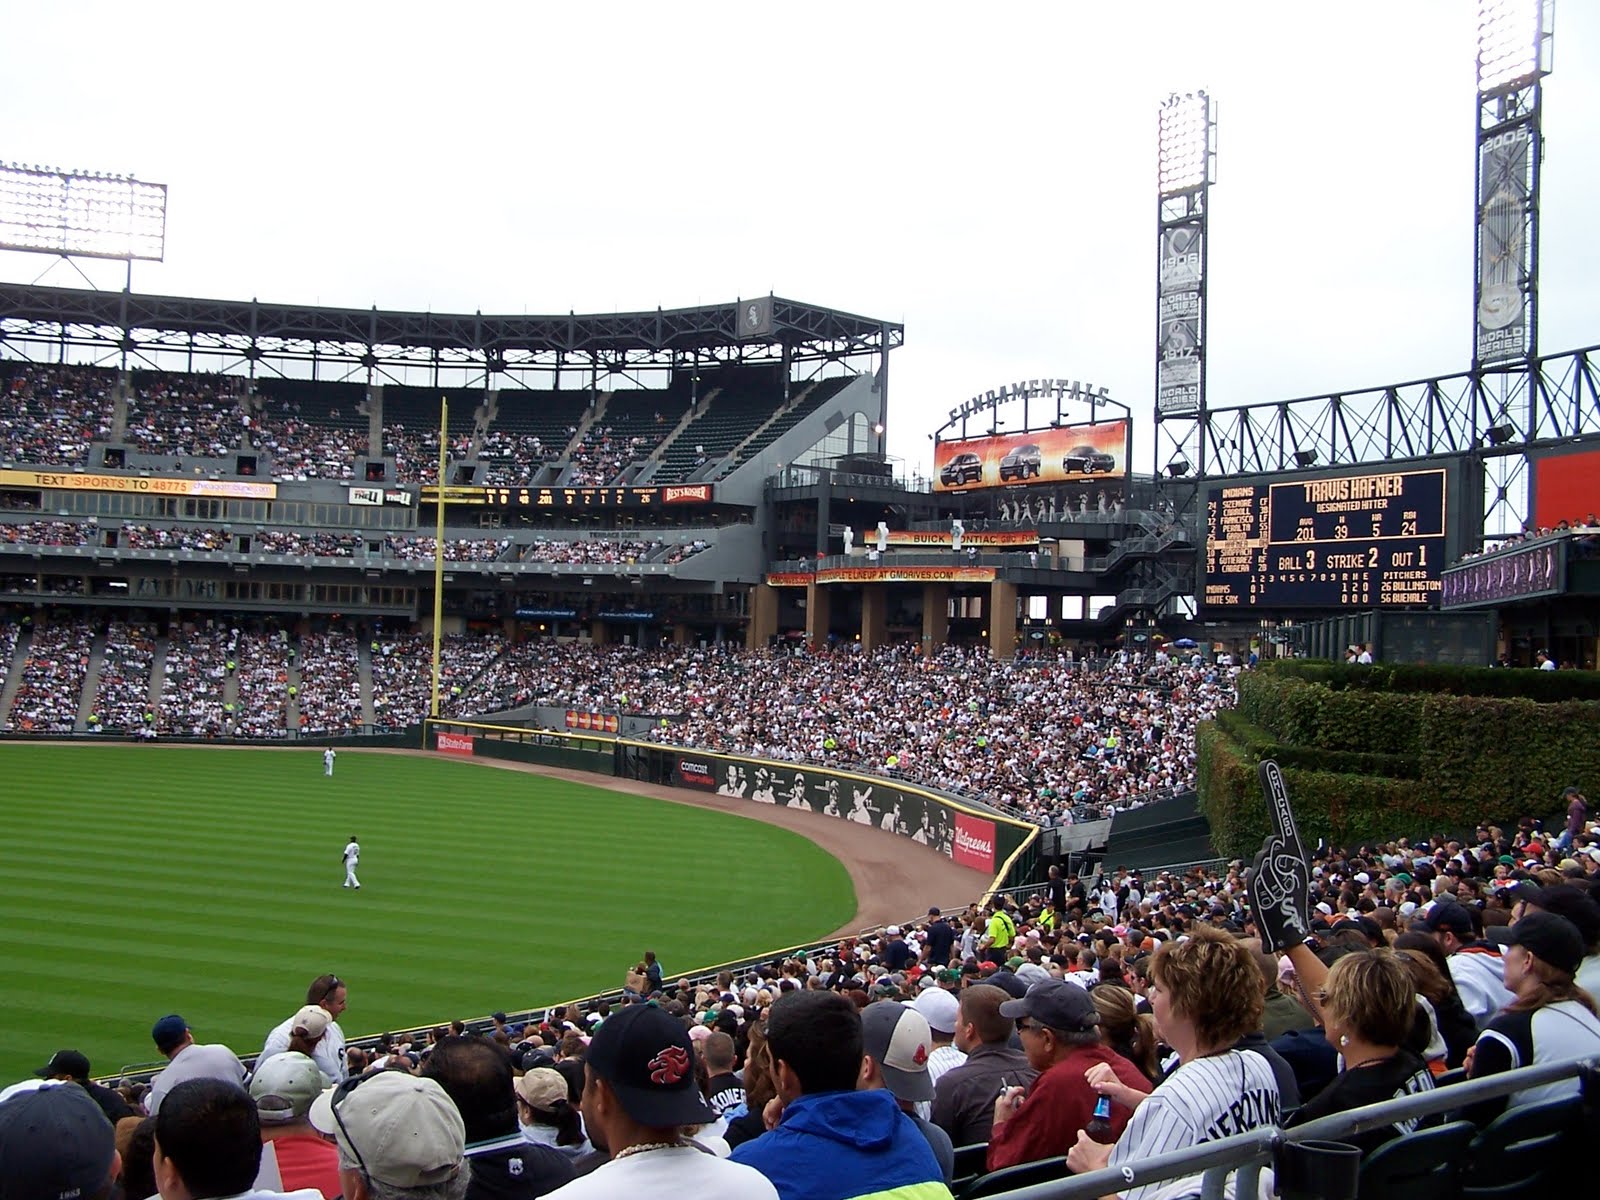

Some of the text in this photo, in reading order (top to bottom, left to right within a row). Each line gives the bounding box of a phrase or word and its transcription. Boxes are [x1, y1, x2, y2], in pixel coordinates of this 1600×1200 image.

[1483, 128, 1528, 152] 2005
[1480, 327, 1524, 344] WORLD
[1480, 337, 1524, 354] SERIES
[1163, 346, 1194, 361] 1917
[1162, 386, 1197, 398] WORLD
[948, 378, 1109, 428] FUNDAMENTALS
[1161, 395, 1197, 406] SERIES
[34, 474, 67, 486] TEXT
[133, 480, 149, 490] TO
[152, 481, 187, 492] 48775
[1304, 476, 1403, 503] TRAVIS HAFNER
[584, 495, 590, 504] 2
[601, 495, 606, 504] 1
[617, 495, 622, 504] 2
[1222, 487, 1254, 499] INDIANS
[1316, 499, 1388, 513] DESIGNATED HITTER
[1294, 521, 1417, 541] .201 39 5 24
[913, 534, 945, 543] BUICK
[952, 535, 996, 544] ONTIAC
[1278, 545, 1427, 571] BALL 3 STRIKE 2 OUT 1
[854, 570, 877, 579] LINEUP
[878, 570, 889, 579] AT
[1280, 574, 1286, 582] 4
[1330, 573, 1336, 581] 9
[1363, 572, 1369, 580] E
[1383, 571, 1427, 580] PITCHERS
[1260, 584, 1264, 593] 1
[1342, 583, 1347, 592] 1
[1352, 583, 1358, 592] 2
[1363, 582, 1368, 592] 0
[1381, 581, 1441, 591] 26 BULLINGTON
[1206, 595, 1224, 604] WHITE
[1250, 595, 1256, 604] 0
[1342, 594, 1347, 603] 0
[1352, 594, 1358, 603] 0
[1363, 593, 1368, 603] 0
[1381, 593, 1391, 603] 56
[681, 761, 708, 775] comcast
[1269, 770, 1293, 837] CHICAGO
[955, 826, 992, 853] Walgreens
[1122, 1166, 1134, 1184] 9
